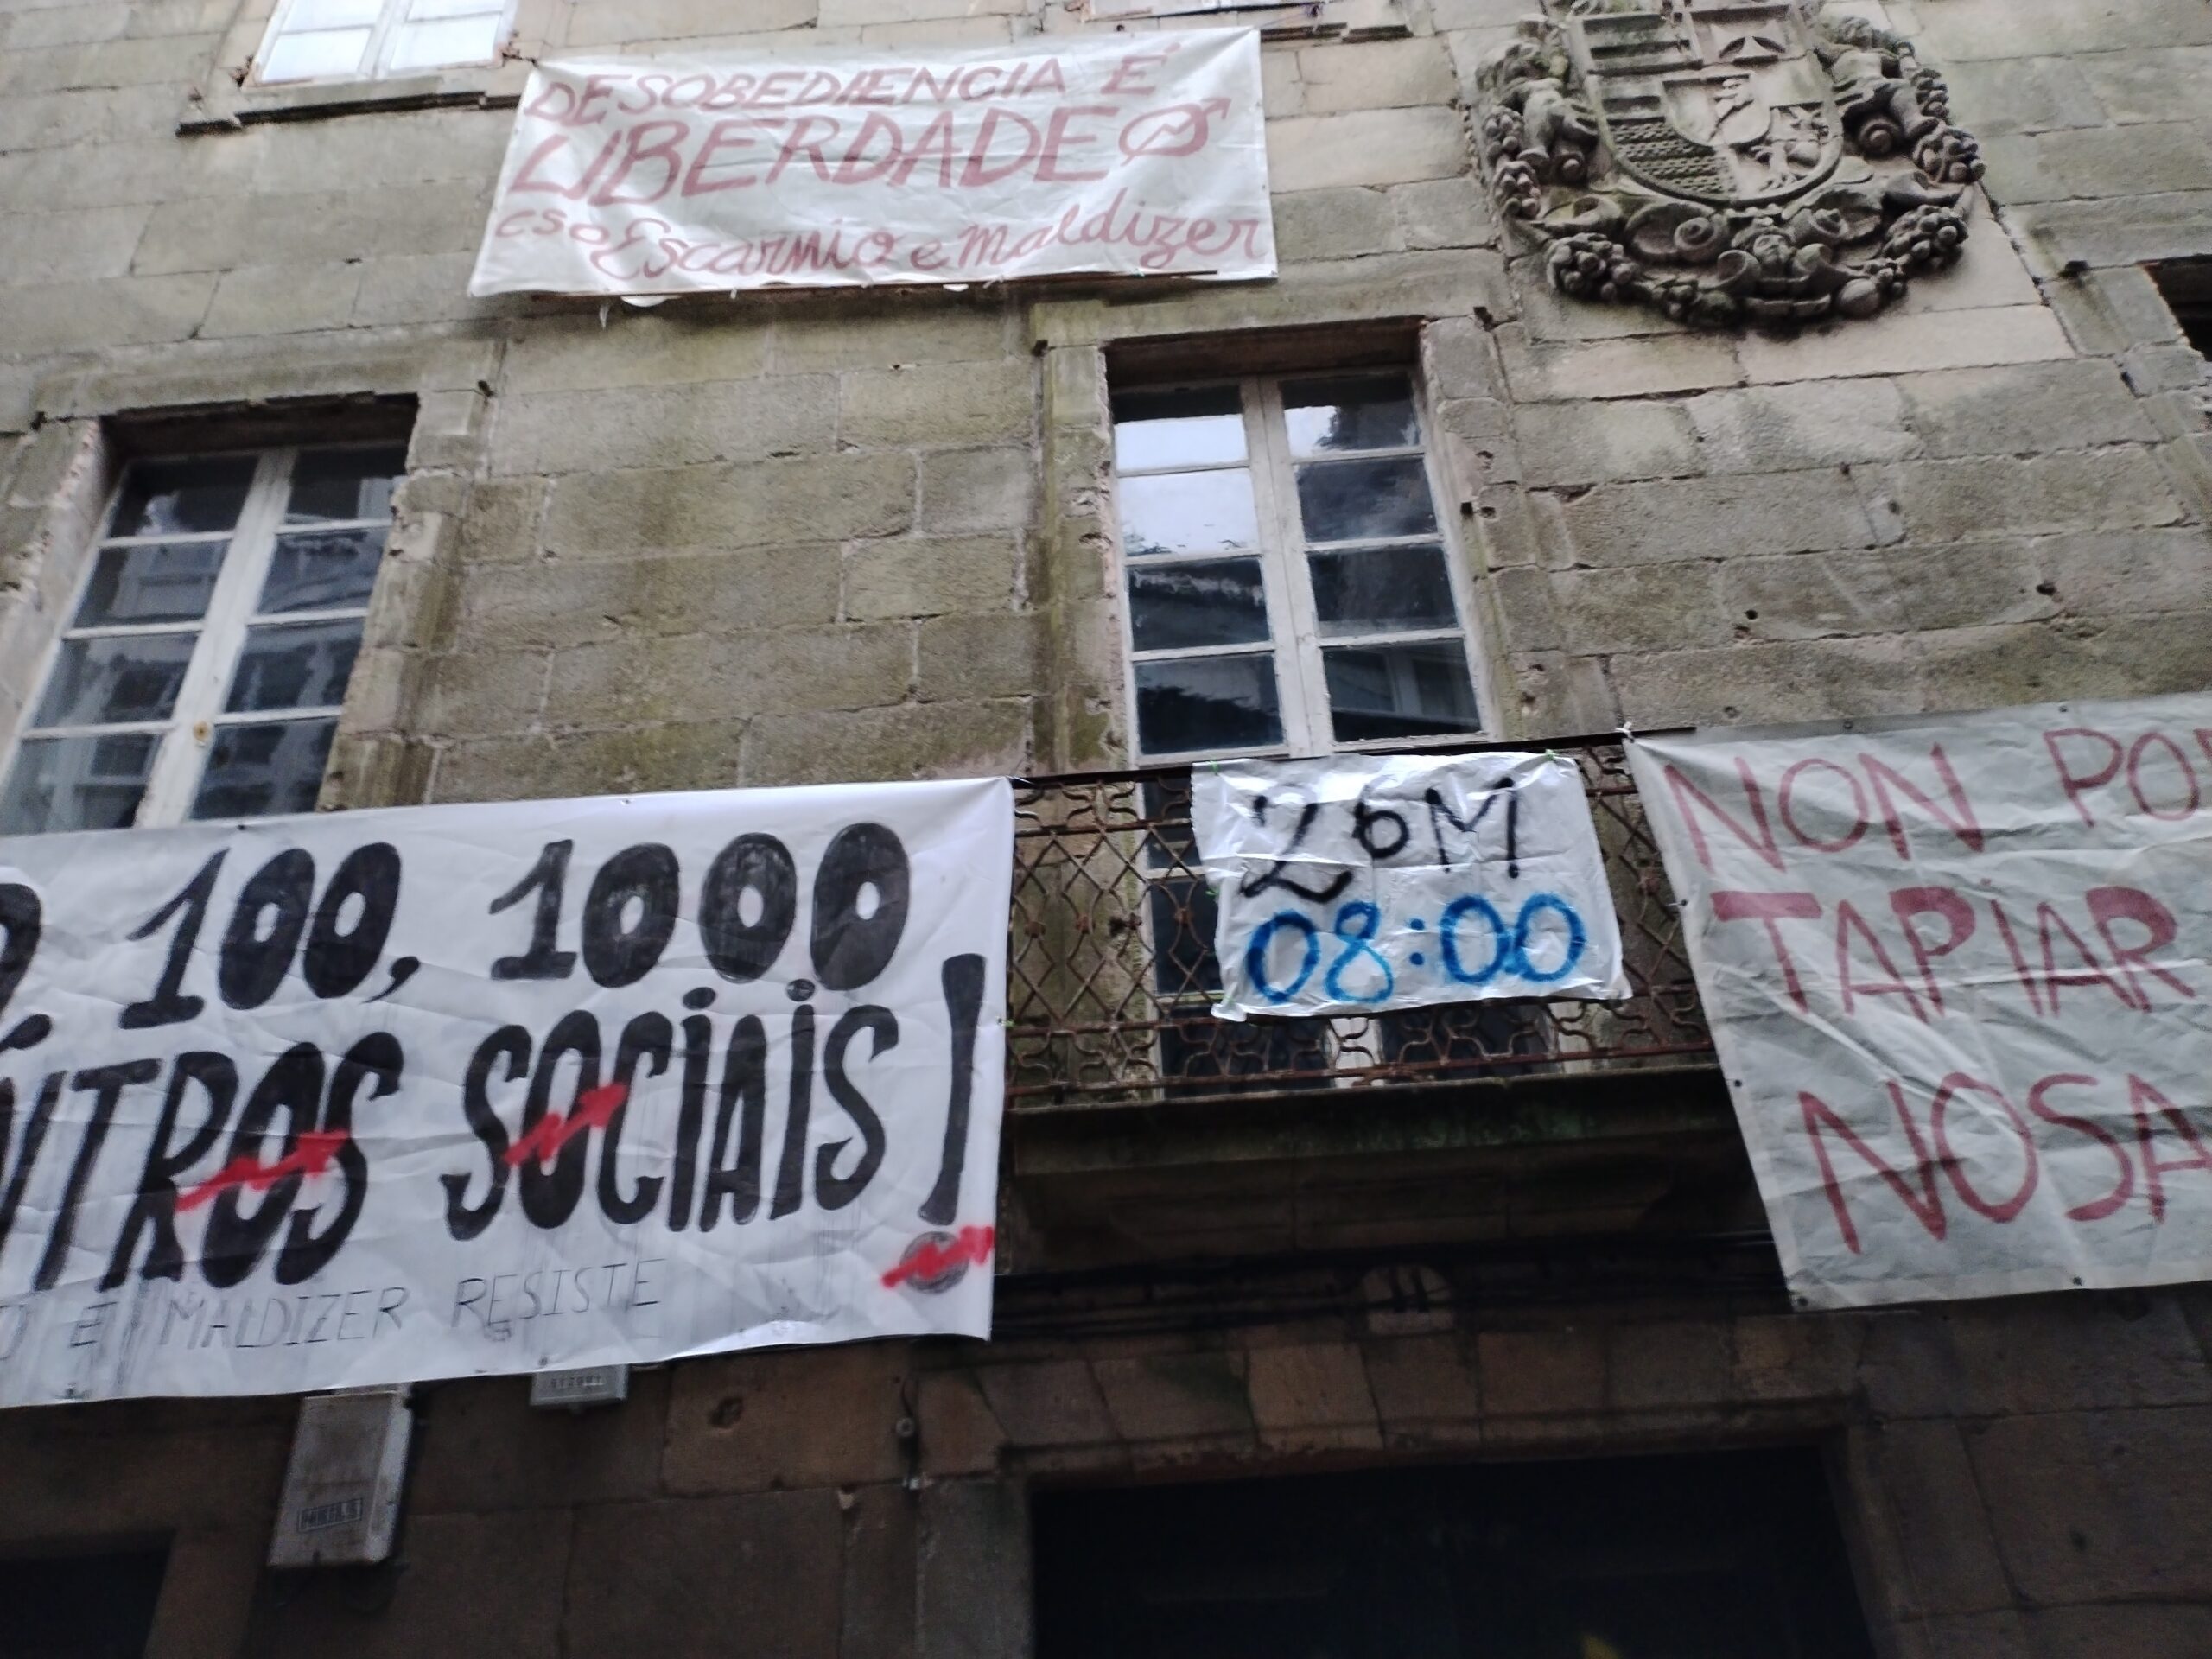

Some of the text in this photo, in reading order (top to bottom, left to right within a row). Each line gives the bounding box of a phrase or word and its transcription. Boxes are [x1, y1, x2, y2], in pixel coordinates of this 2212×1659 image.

[524, 57, 1066, 127] DESOBEDIENCIA
[506, 105, 1121, 207] LIBERDADE
[910, 238, 950, 271] e
[1663, 728, 2212, 874] NON PO
[118, 841, 420, 1030] 100,
[488, 822, 911, 991] 1000
[1246, 892, 1588, 1005] 08:00
[1798, 1071, 2212, 1255] NOSA
[156, 1287, 410, 1351] MALDIZER
[451, 1258, 667, 1331] RESISTE
